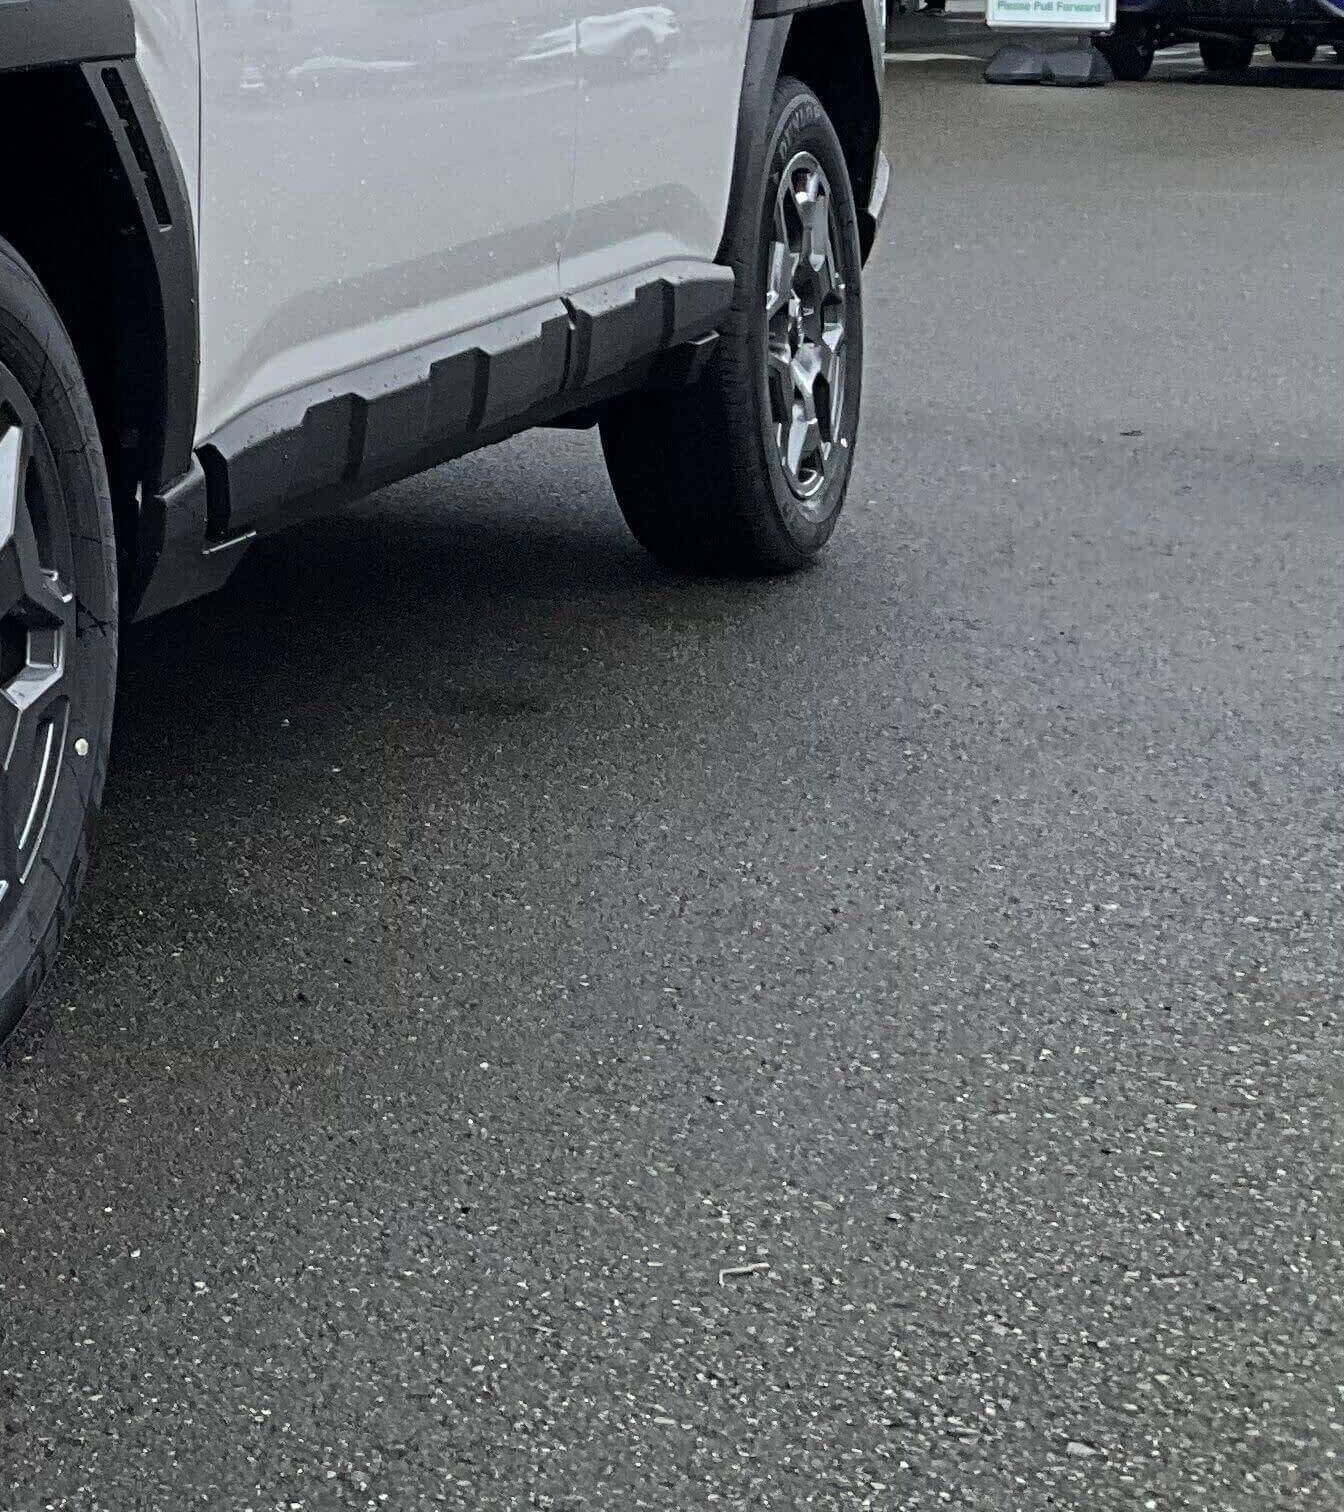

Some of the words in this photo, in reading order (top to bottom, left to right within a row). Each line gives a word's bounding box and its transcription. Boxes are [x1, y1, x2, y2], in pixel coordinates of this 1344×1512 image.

[997, 0, 1031, 10] Please
[1034, 0, 1054, 11] Pull
[1057, 0, 1101, 12] Forward
